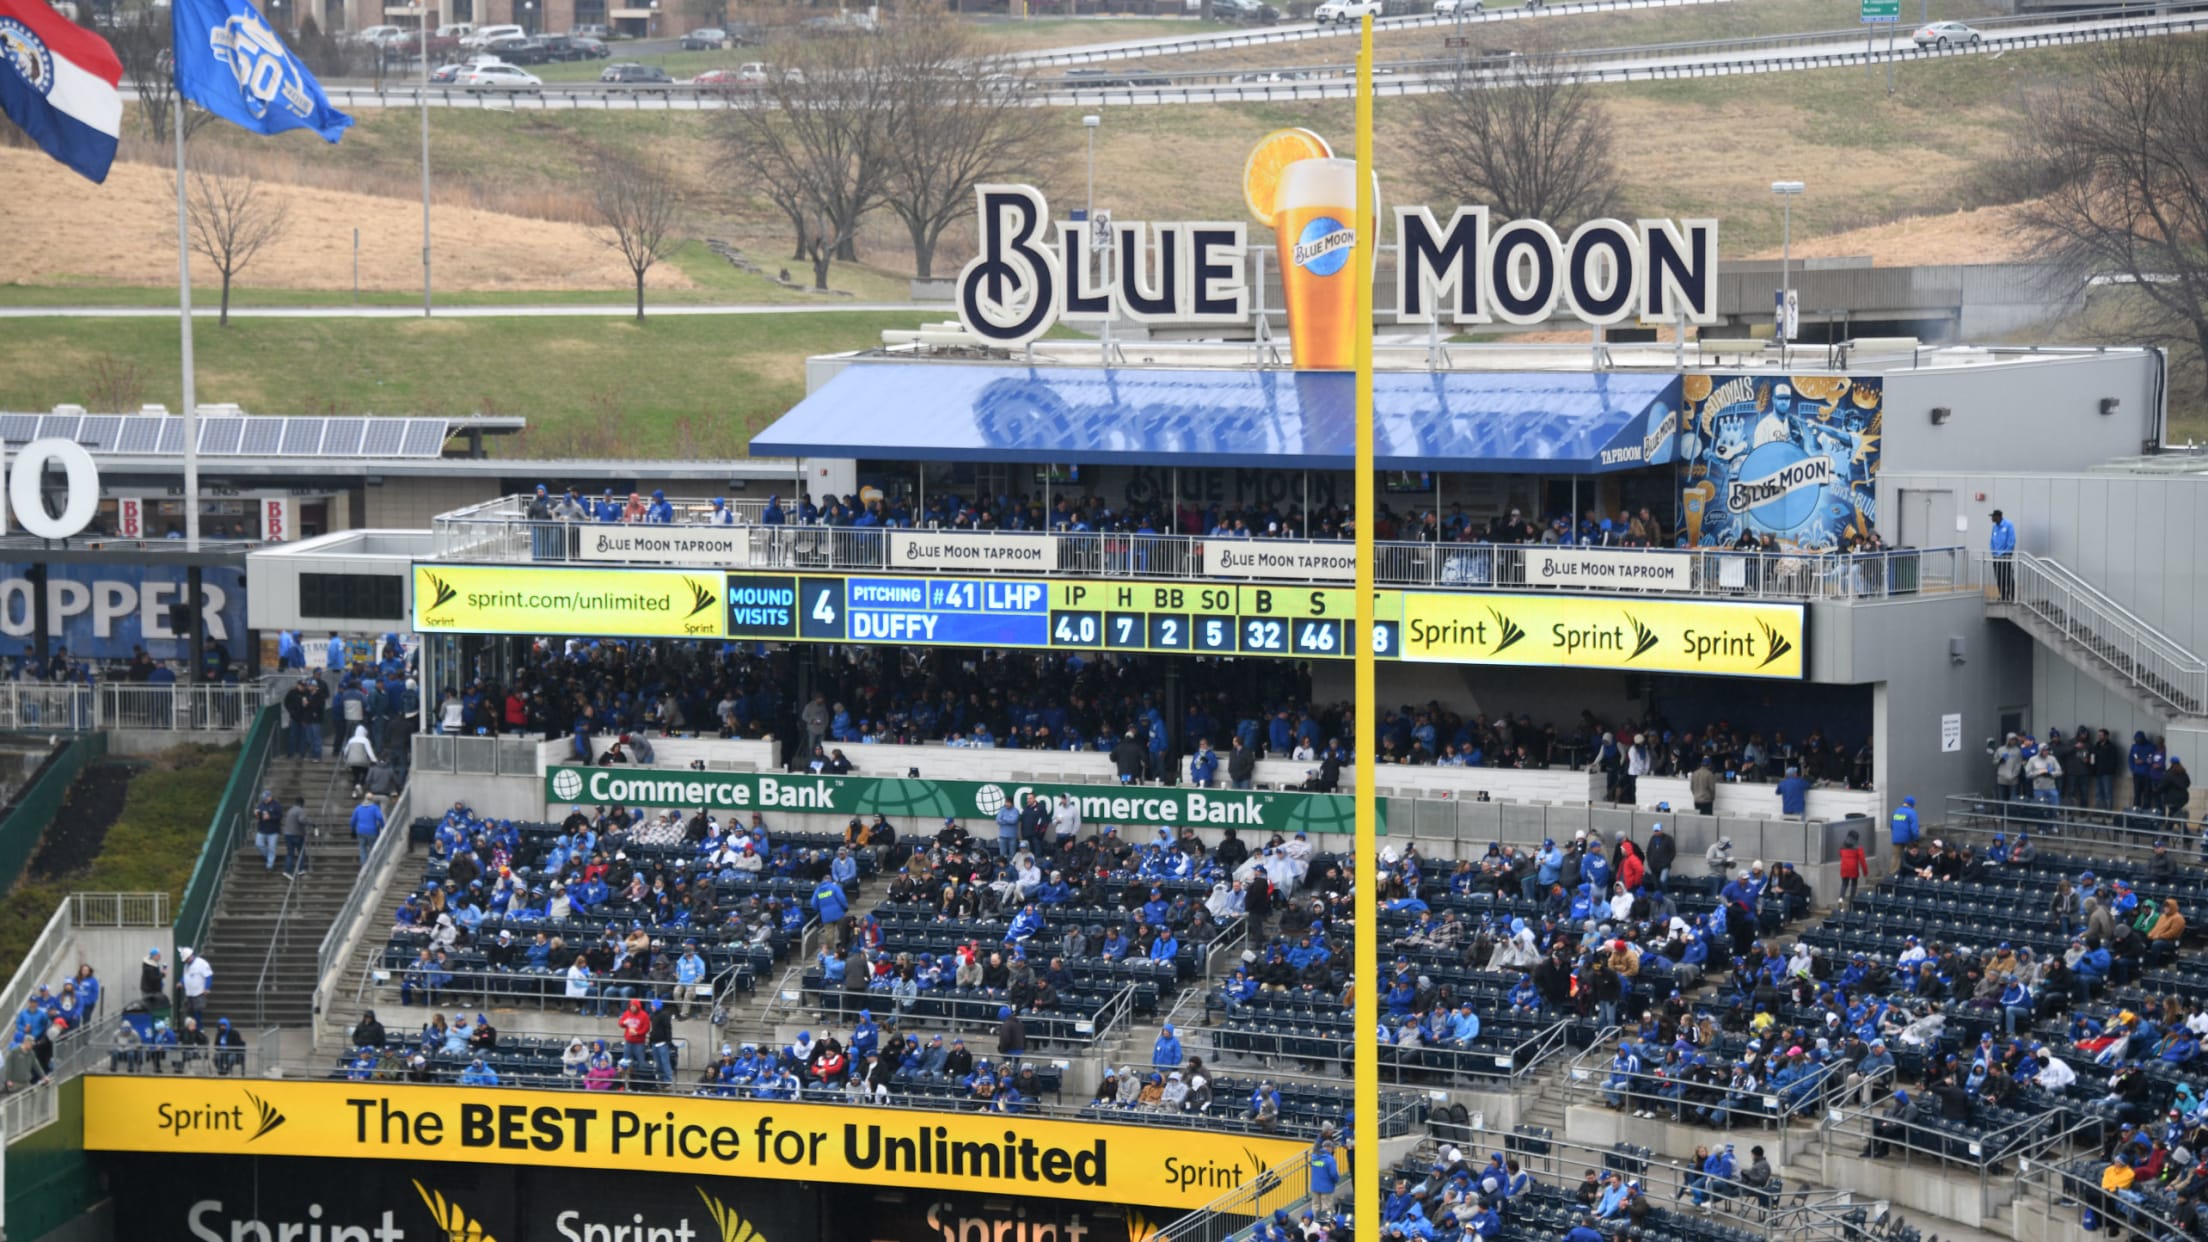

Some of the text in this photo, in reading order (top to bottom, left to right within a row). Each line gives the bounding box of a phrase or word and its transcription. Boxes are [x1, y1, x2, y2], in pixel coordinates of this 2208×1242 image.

[1295, 231, 1354, 264] BLUE MOON
[958, 186, 1716, 344] BLUE MOON
[1660, 416, 1675, 439] MOON
[1600, 446, 1642, 464] TAPROOM
[0, 437, 99, 538] O
[1729, 479, 1779, 510] BLUE
[1780, 461, 1826, 487] MOON
[597, 534, 733, 553] BLUE MOON TAPROOM
[906, 541, 1042, 560] BLUE MOON TAPROOM
[1220, 549, 1356, 568] BLUE MOON TAPROOM
[1542, 557, 1675, 578] BLUE MOON TAPROOM
[468, 588, 671, 616] sprint.com/unlimited
[729, 587, 793, 607] MOUND
[812, 589, 836, 625] 4
[853, 583, 1041, 610] PITCHING #41 LHP
[1064, 586, 1326, 615] IP H BB SO B S
[425, 616, 456, 629] Sprint
[683, 621, 714, 634] Sprint
[734, 607, 790, 626] VISITS
[853, 614, 938, 640] DUFFY
[1054, 616, 1095, 642] 4.0
[1117, 618, 1133, 643] 7
[1161, 620, 1177, 645] 2
[1206, 621, 1222, 646] 5
[1248, 622, 1280, 649] 32
[1300, 624, 1334, 650] 46
[1410, 618, 1755, 661] Sprint Sprint Sprint
[589, 772, 750, 805] Commerce
[758, 778, 834, 808] Bank
[1187, 793, 1264, 825] Bank
[158, 1103, 243, 1136] Sprint
[346, 1098, 1107, 1186] The BEST Price for Unlimited
[1164, 1156, 1243, 1189] Sprint
